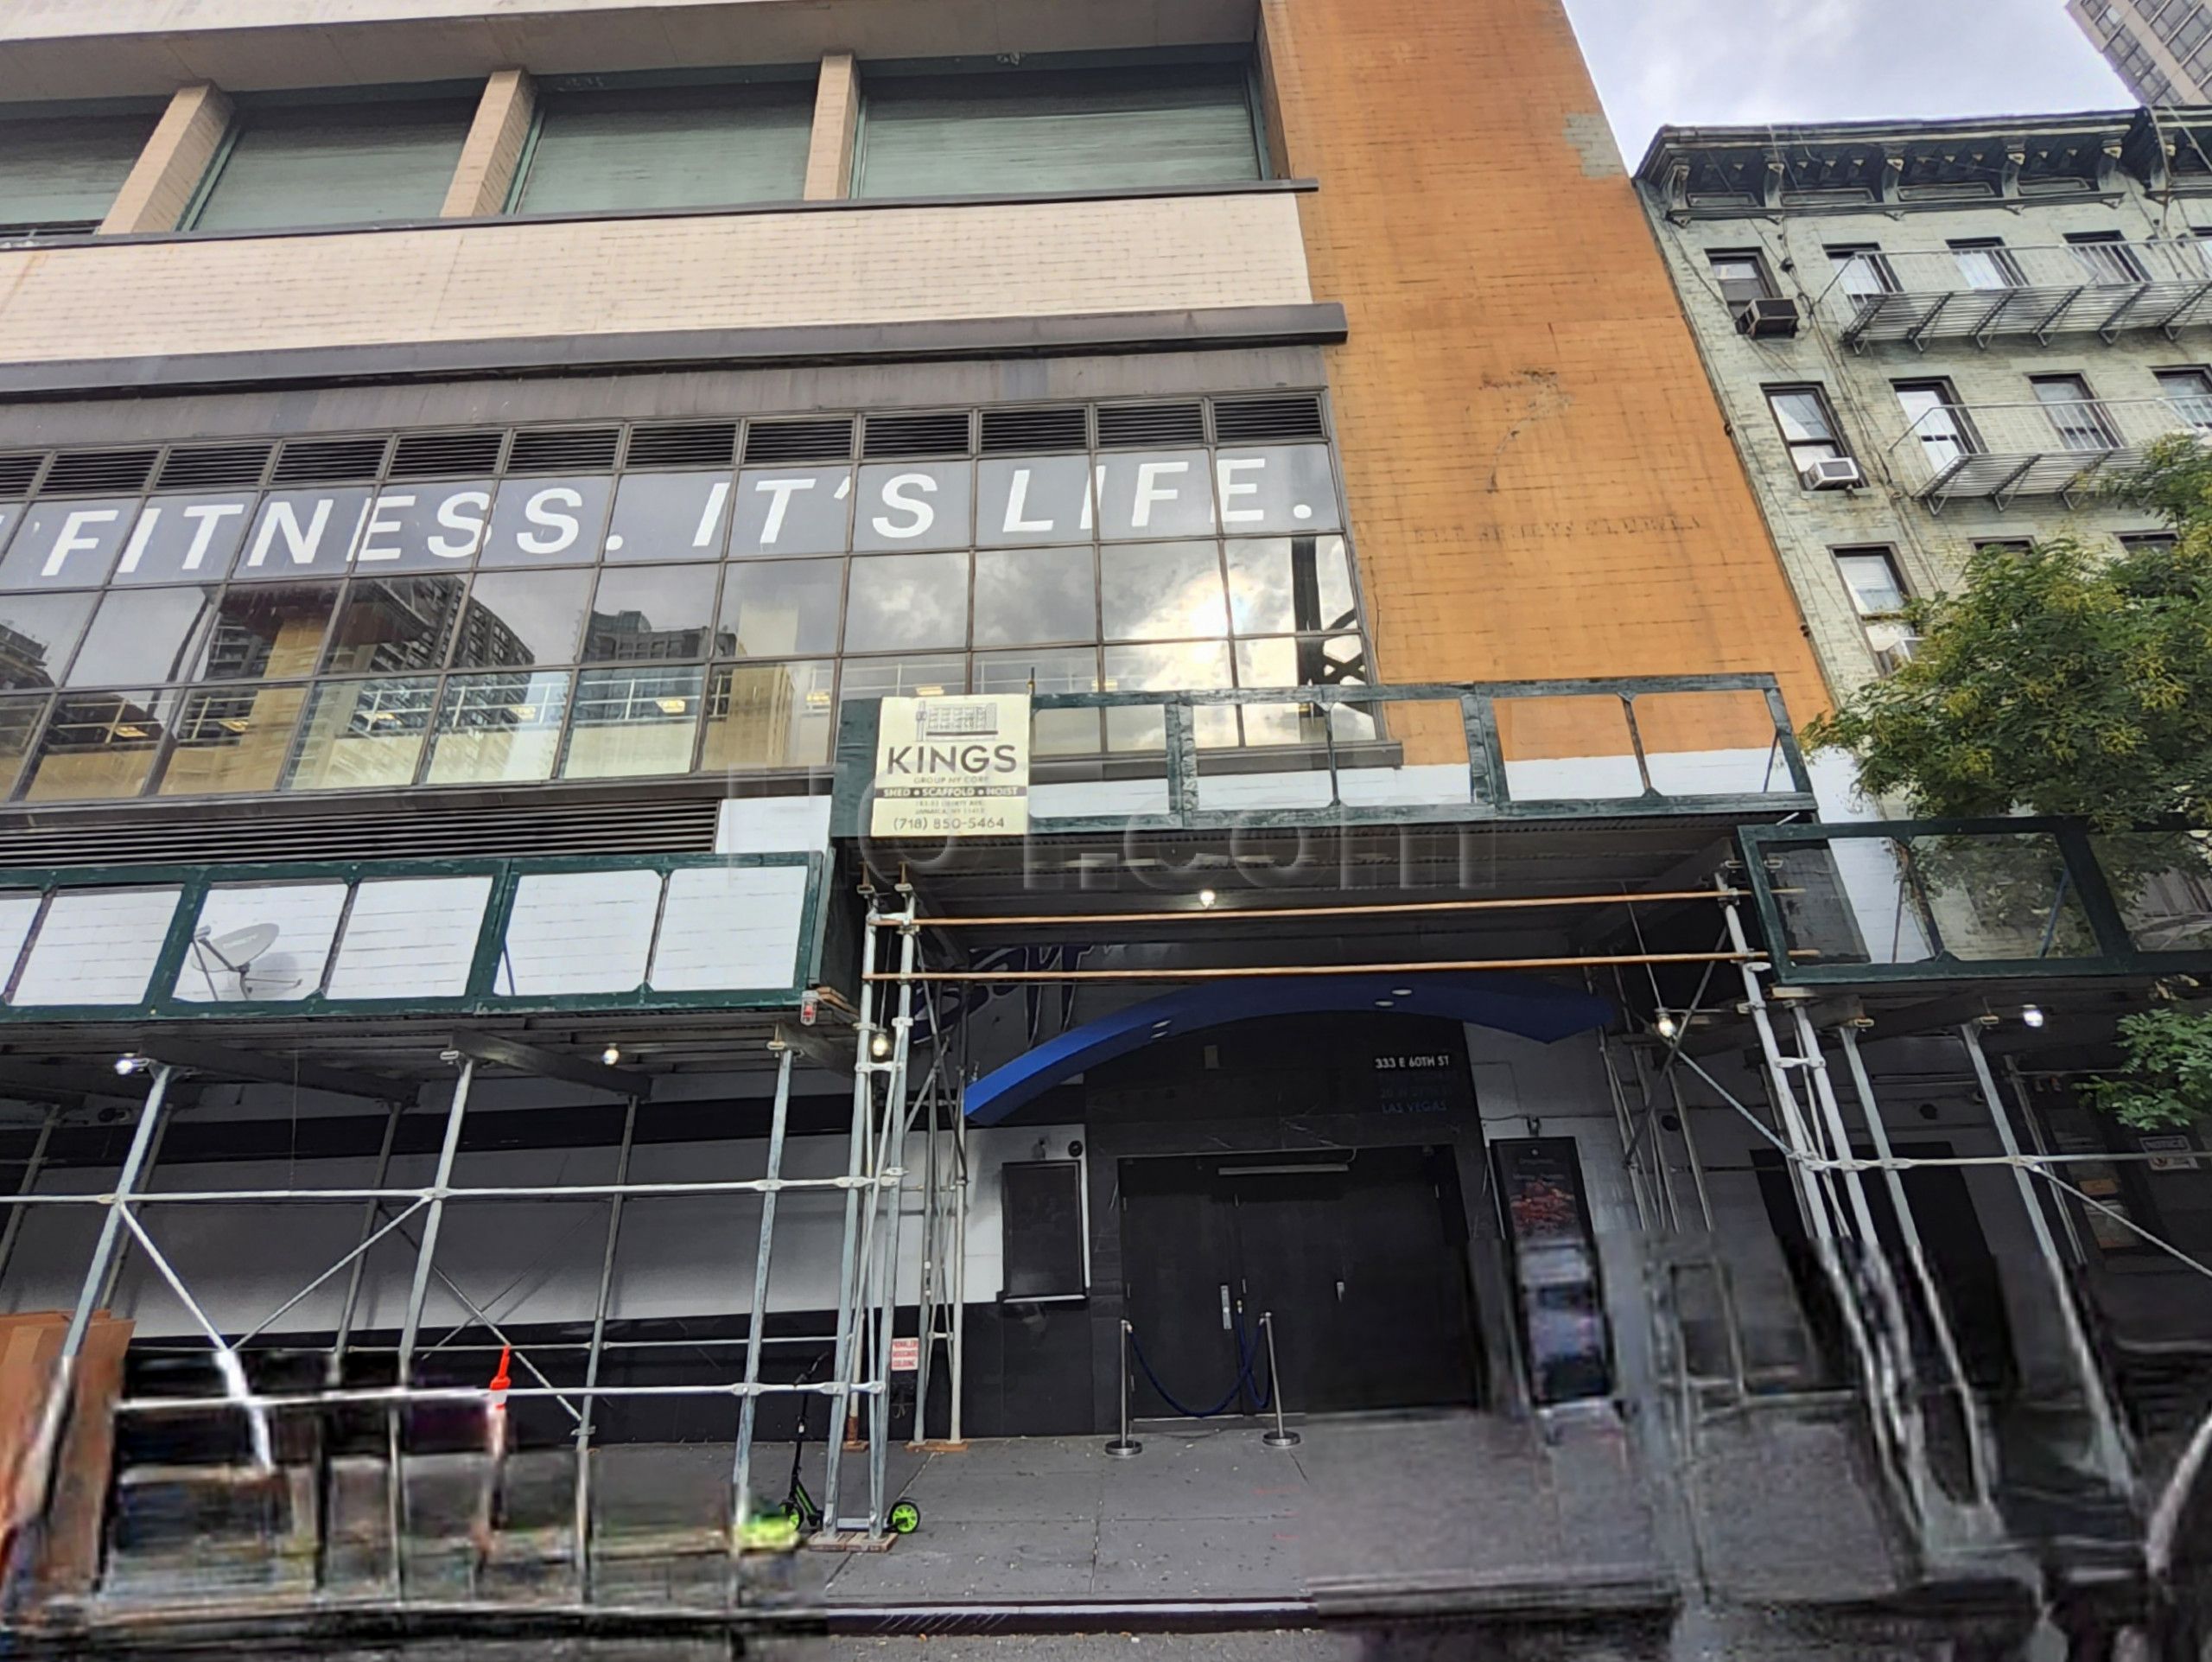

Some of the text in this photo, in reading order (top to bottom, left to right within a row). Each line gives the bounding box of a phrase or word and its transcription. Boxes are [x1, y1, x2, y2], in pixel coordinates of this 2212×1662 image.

[41, 458, 1313, 576] FITNESS. IT'S LIFE.
[887, 745, 1017, 774] KINGS
[922, 787, 975, 797] SCAFFOLD
[986, 786, 1019, 796] HOIST
[893, 818, 1005, 831] (718) 850-5464
[1375, 1054, 1449, 1069] 333 E 60TH ST
